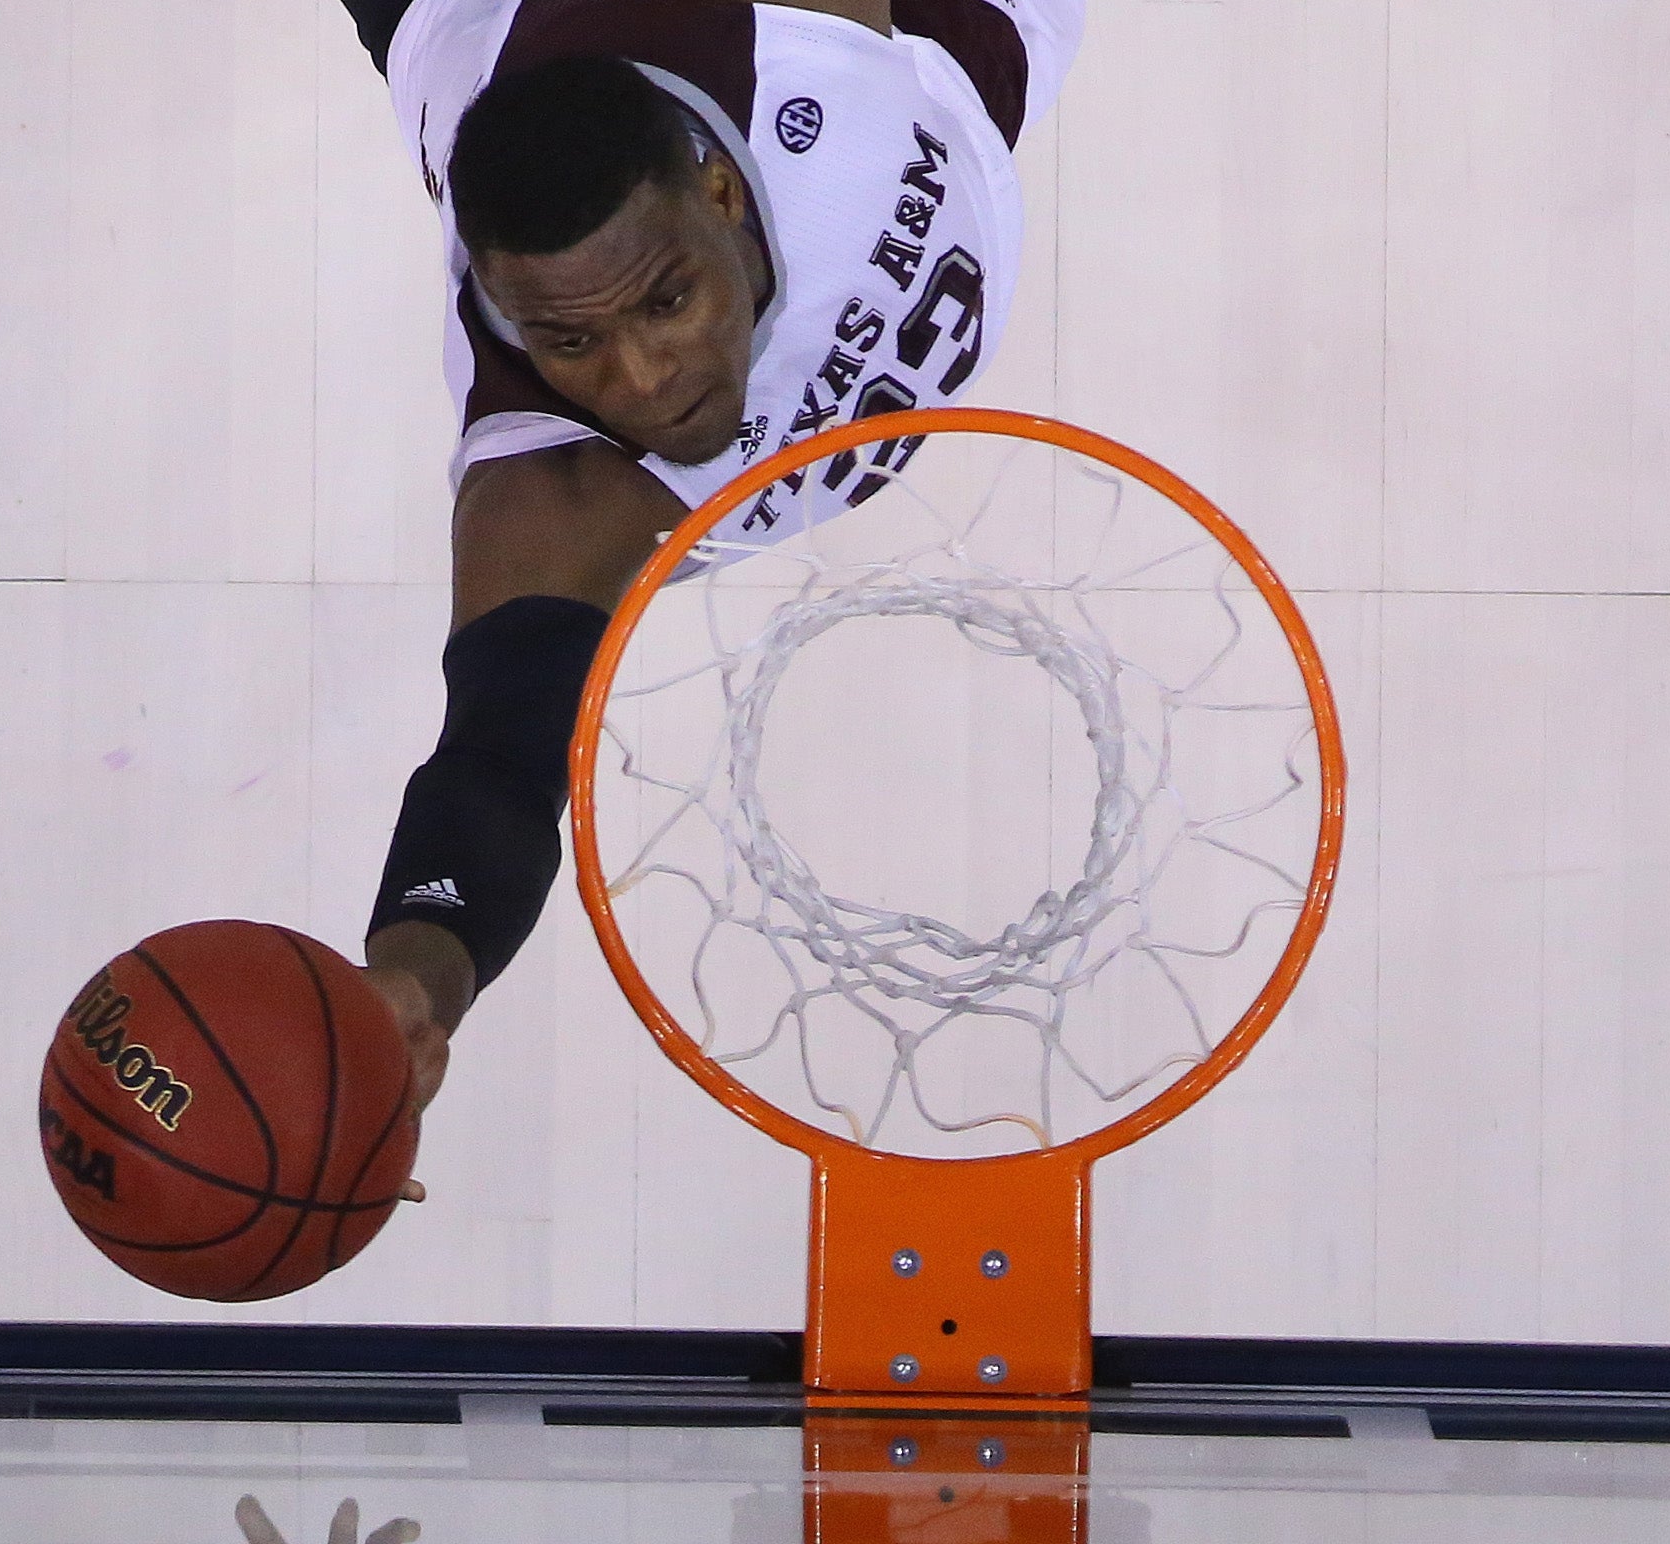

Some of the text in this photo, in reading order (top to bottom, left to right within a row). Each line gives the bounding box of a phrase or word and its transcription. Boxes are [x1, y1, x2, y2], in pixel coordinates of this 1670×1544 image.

[779, 101, 821, 150] SEC
[868, 121, 949, 293] A&M
[742, 414, 769, 466] adidas
